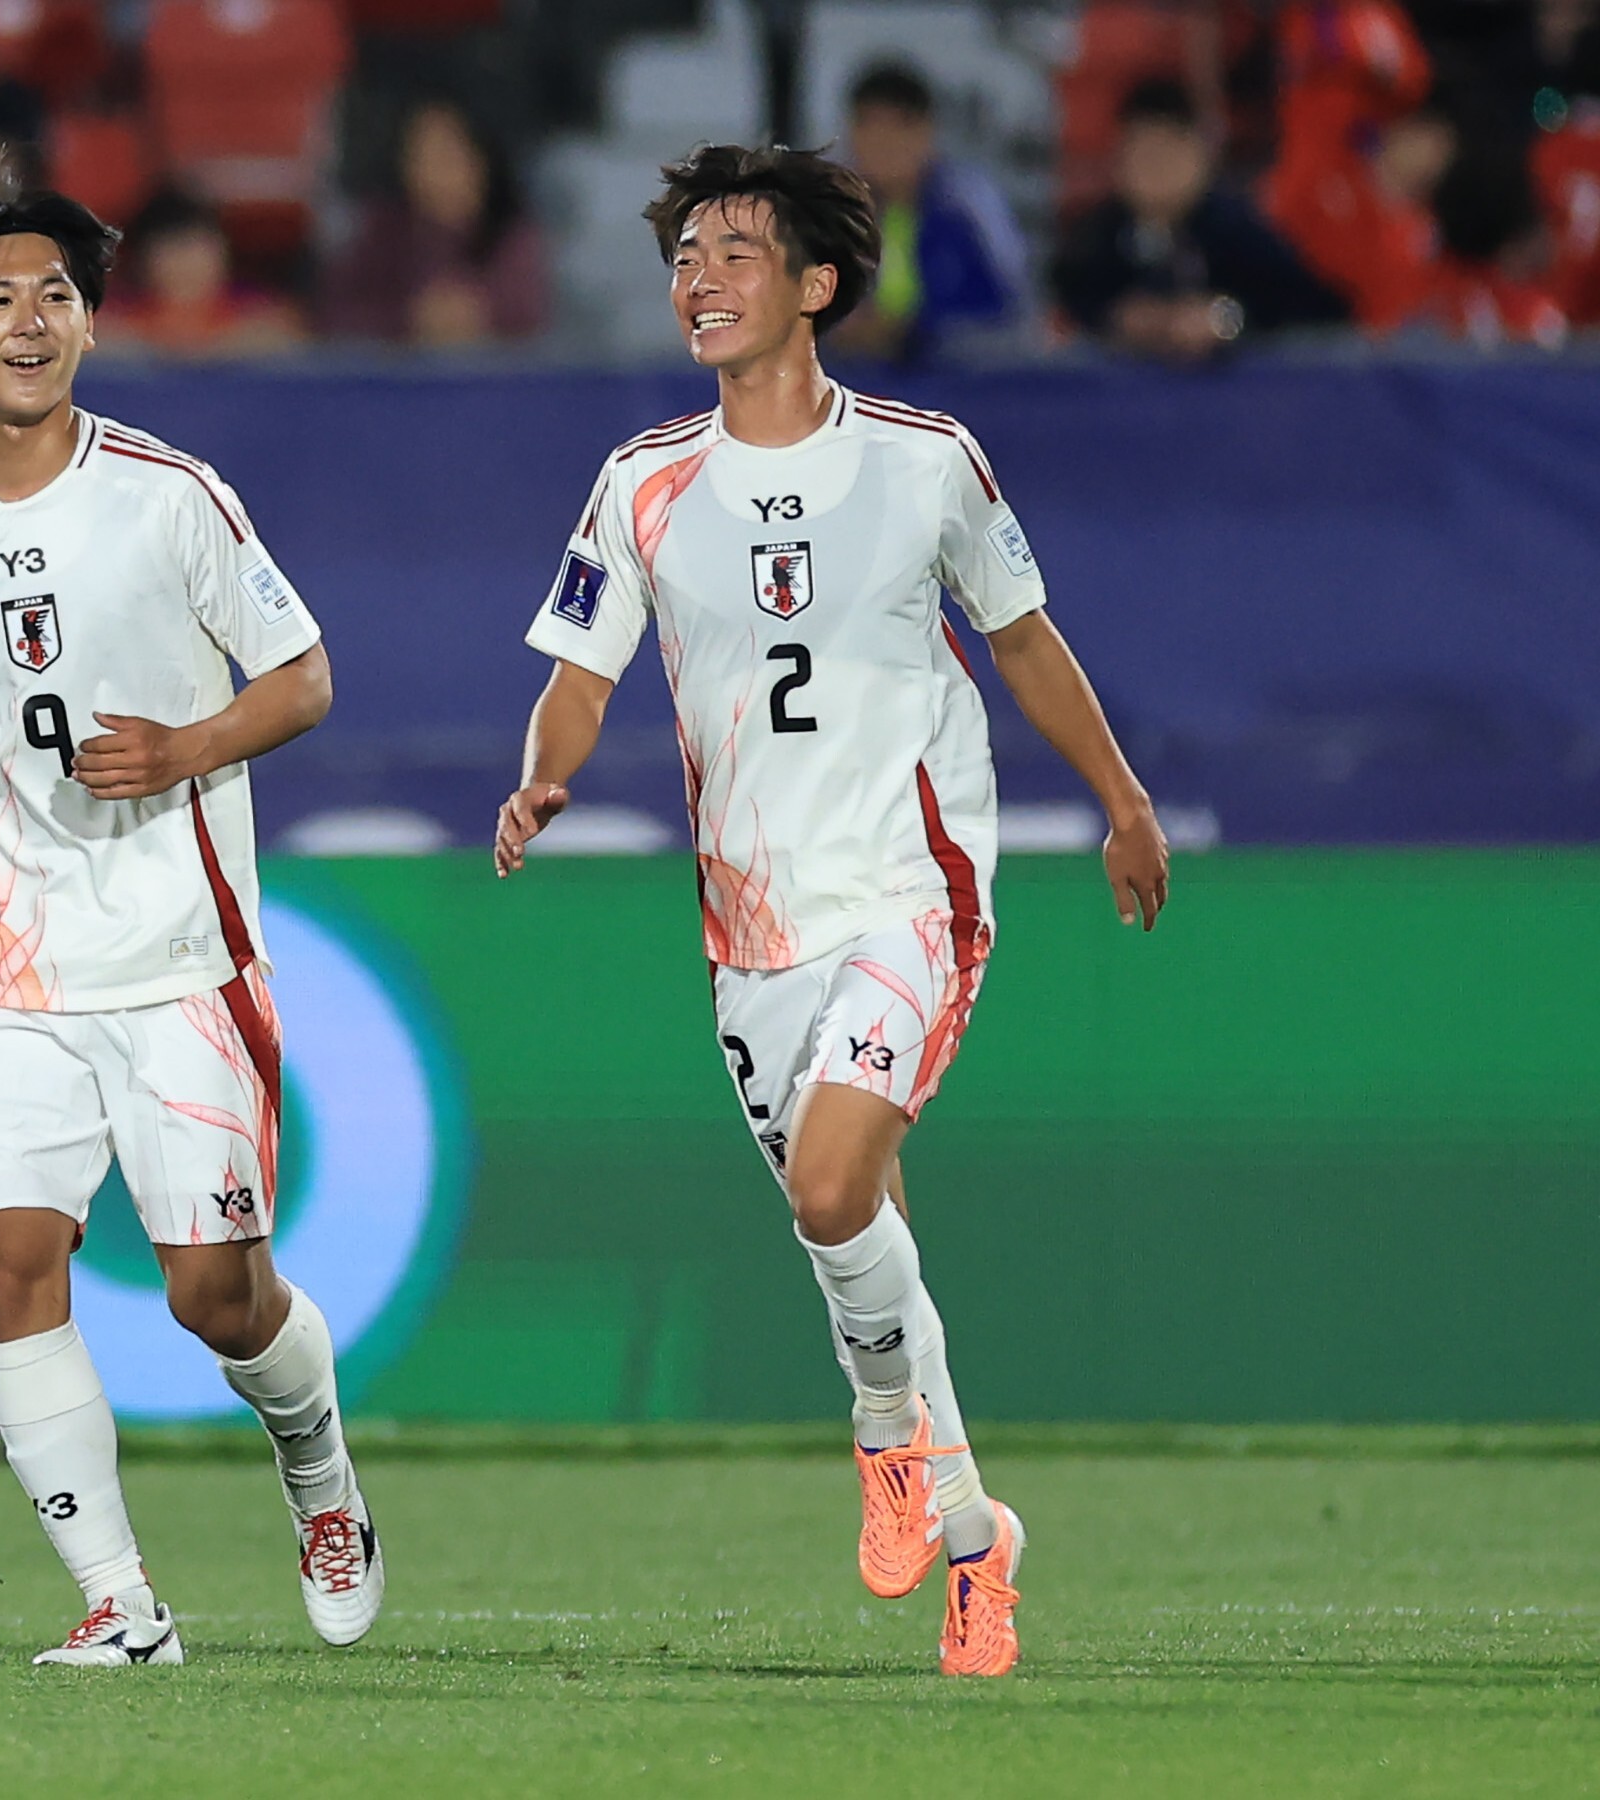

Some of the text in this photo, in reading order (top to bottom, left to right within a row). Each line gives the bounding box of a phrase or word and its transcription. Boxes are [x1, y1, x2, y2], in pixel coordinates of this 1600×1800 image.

[750, 494, 804, 523] Y-3
[764, 543, 798, 554] JAPAN
[13, 597, 44, 608] JAPAN
[765, 643, 818, 734] 2
[22, 693, 76, 779] 9
[848, 1036, 895, 1072] Y-3
[208, 1187, 255, 1218] Y-3
[33, 1491, 79, 1520] -3
